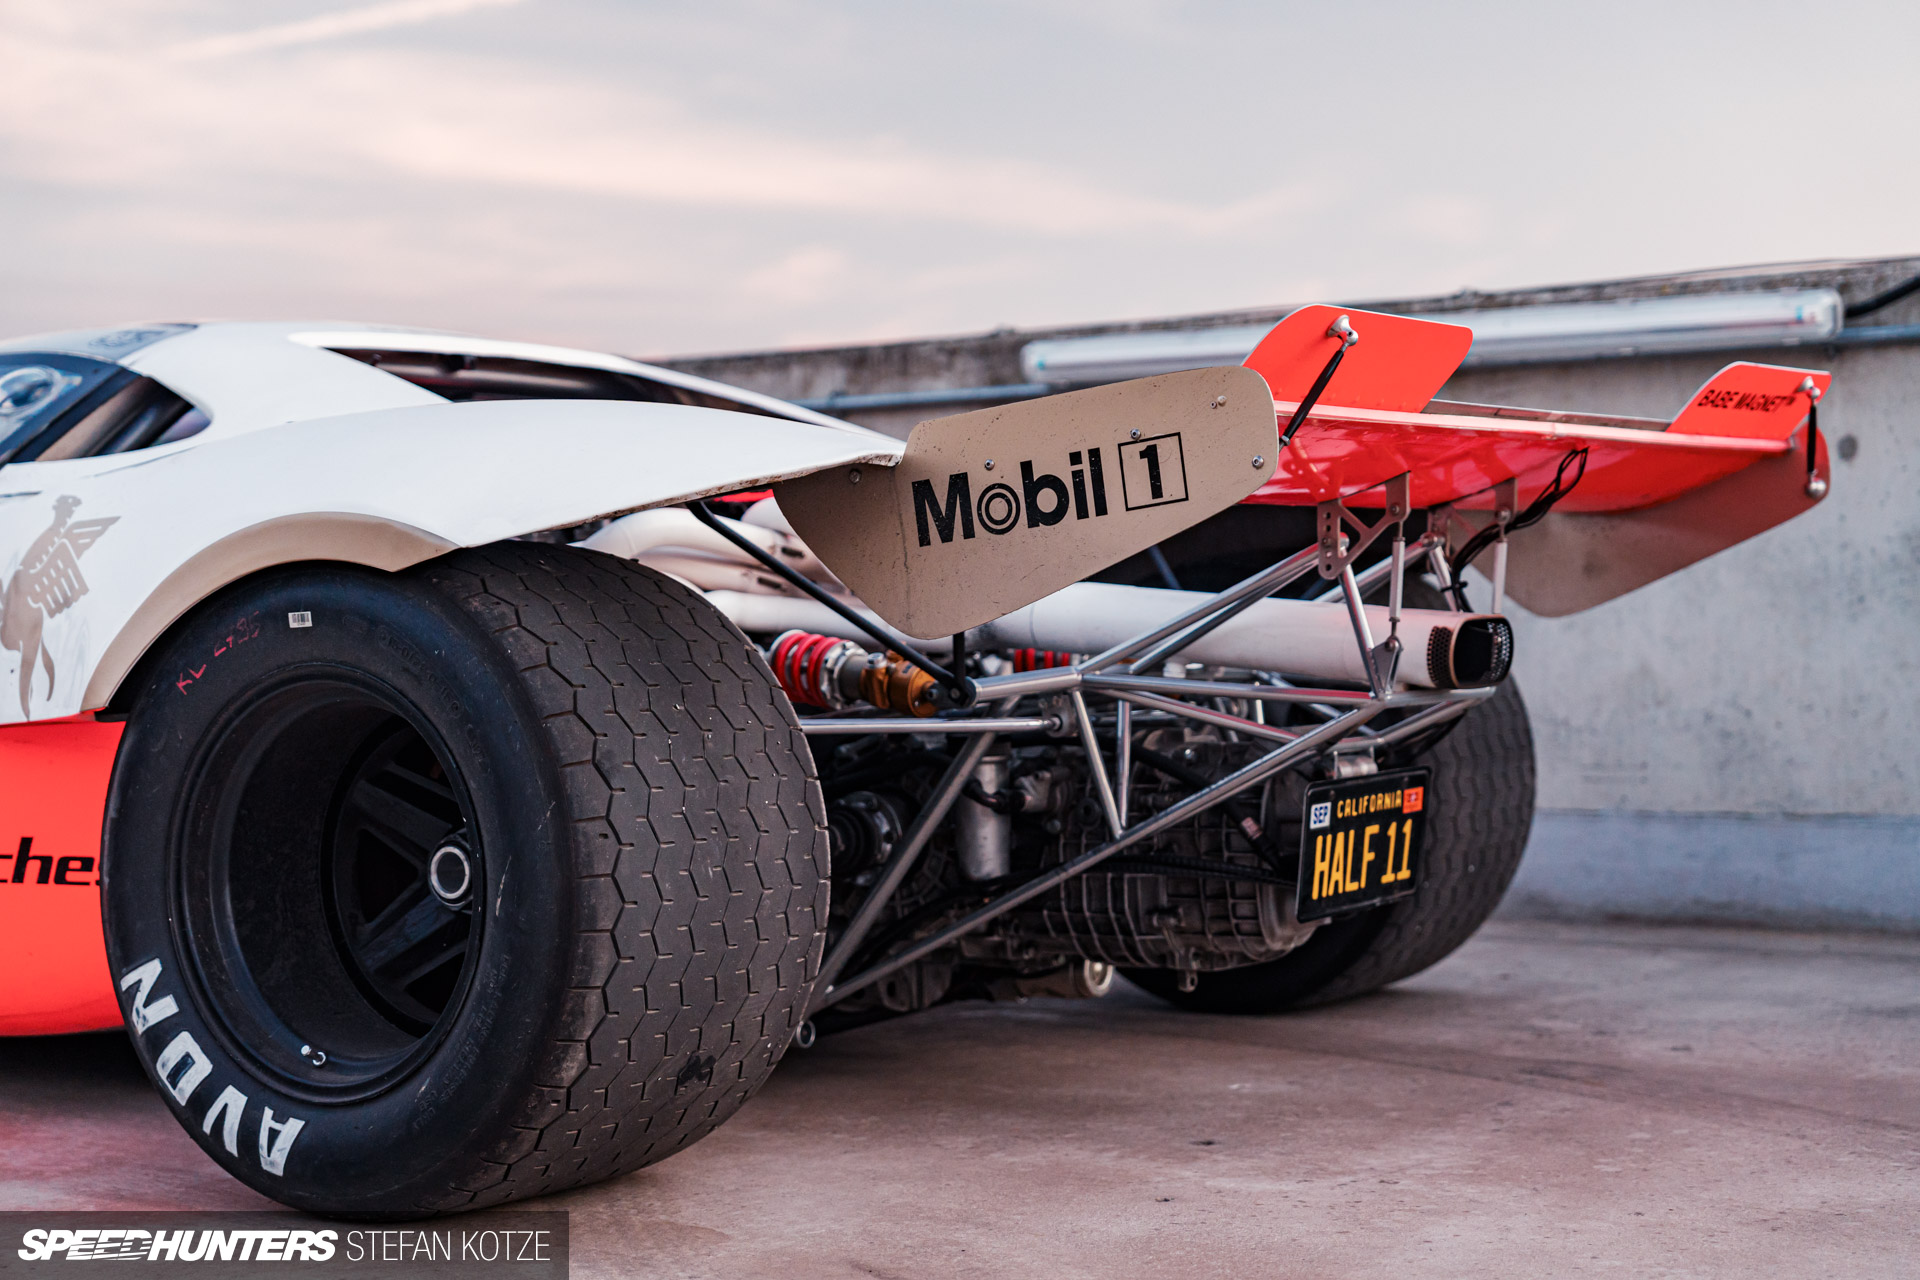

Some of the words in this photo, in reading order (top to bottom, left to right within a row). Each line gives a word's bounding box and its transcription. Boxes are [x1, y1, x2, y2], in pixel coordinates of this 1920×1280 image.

[1697, 389, 1739, 409] BABE
[912, 447, 1108, 547] Mobil
[1139, 443, 1164, 500] 1
[1312, 805, 1329, 825] SEP
[1336, 789, 1403, 819] CALIFORNIA
[1311, 823, 1380, 901] HALF
[1380, 818, 1413, 885] 11
[120, 957, 305, 1177] AVON
